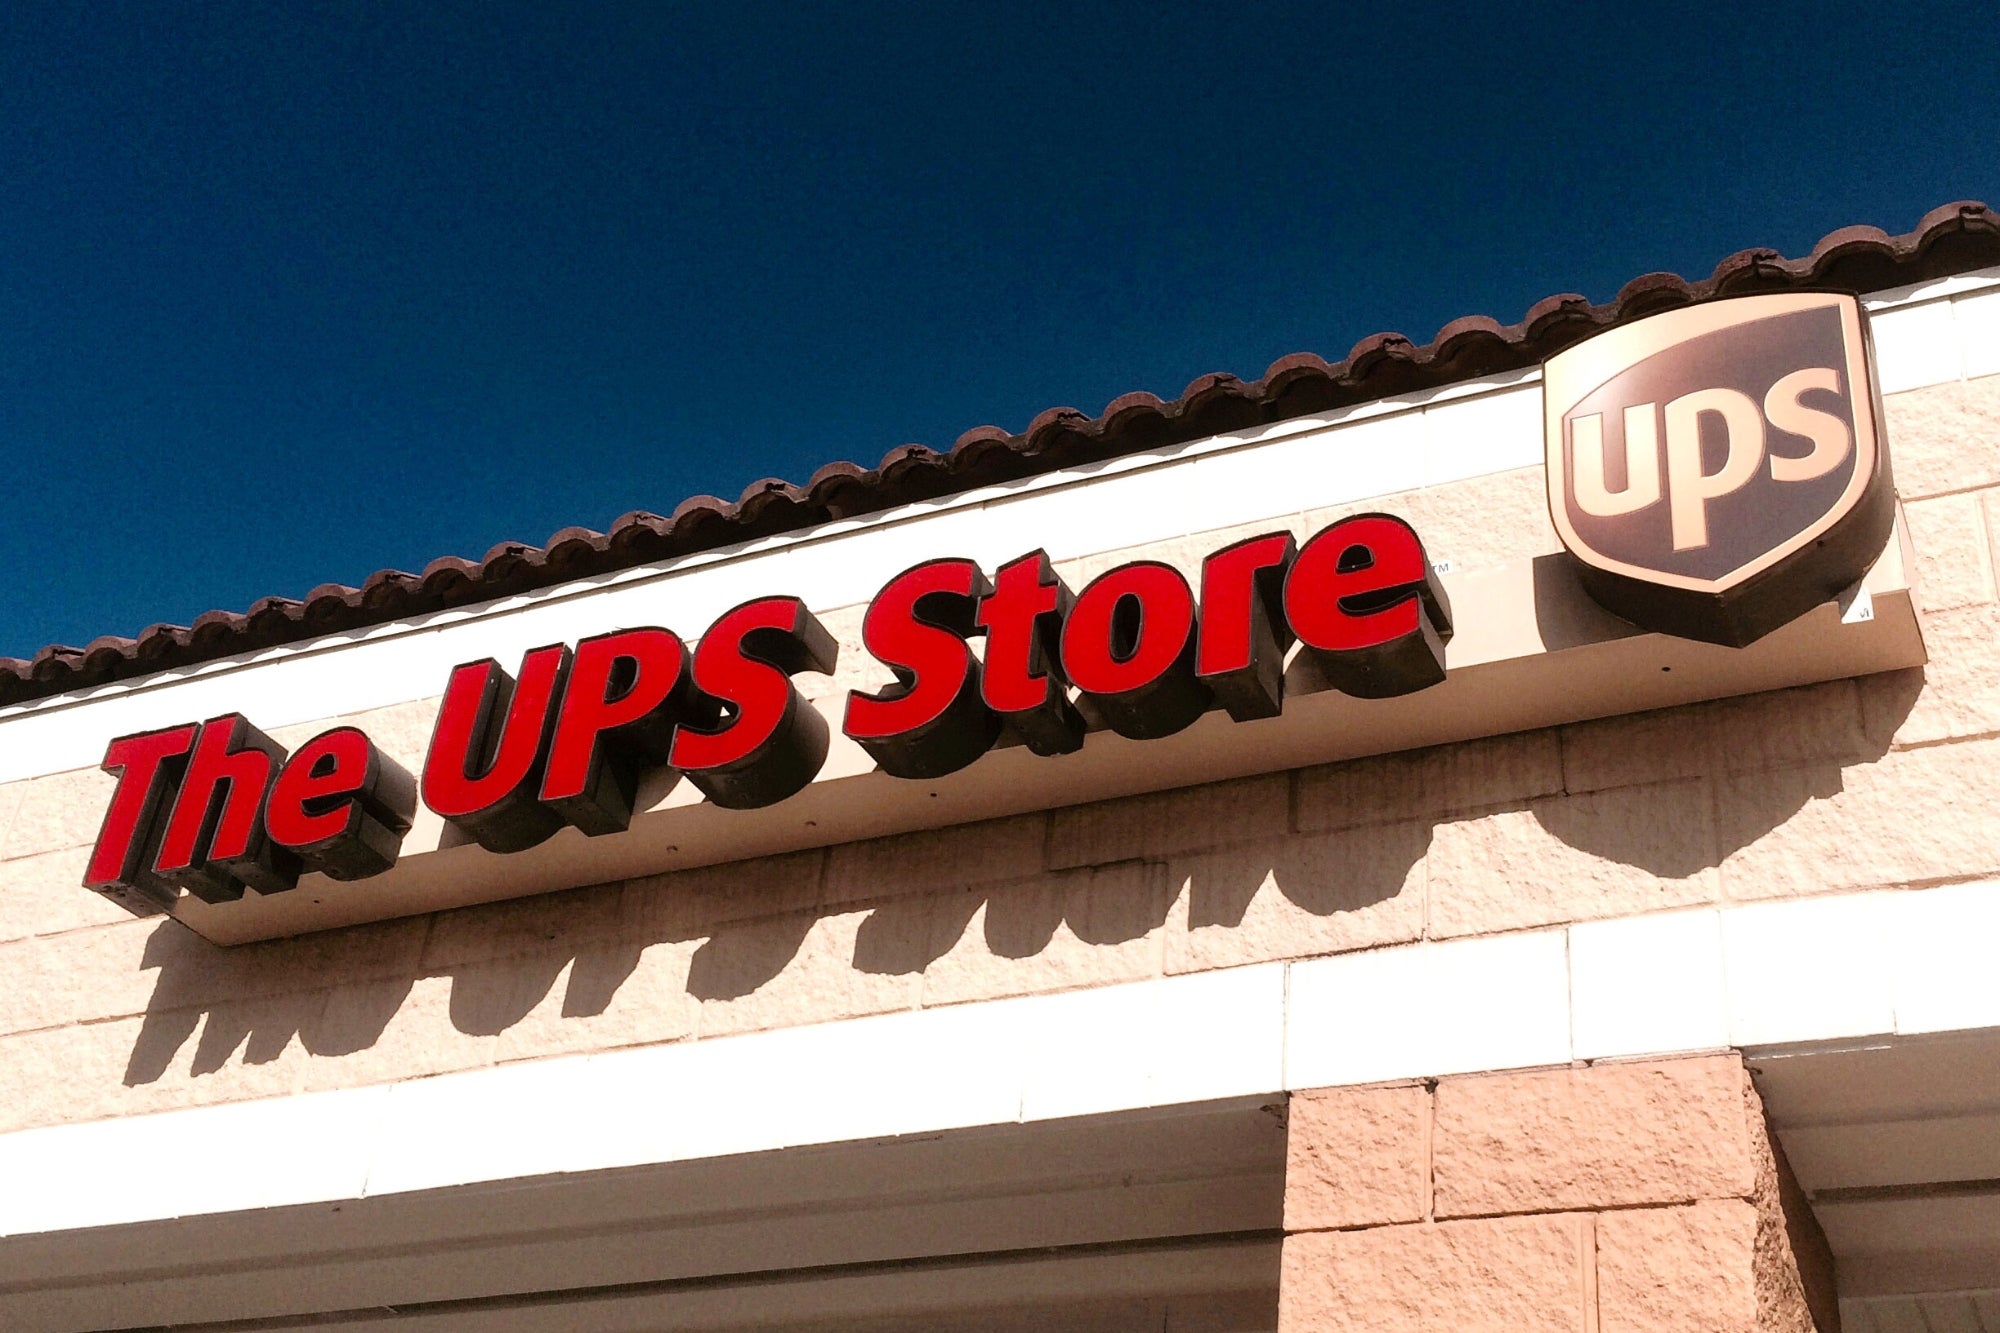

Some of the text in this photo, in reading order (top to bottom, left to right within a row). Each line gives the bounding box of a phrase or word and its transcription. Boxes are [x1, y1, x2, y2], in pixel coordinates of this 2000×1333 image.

[1570, 367, 1851, 552] ups
[86, 716, 370, 885] The
[422, 597, 799, 817] UPS
[844, 515, 1427, 738] Store
